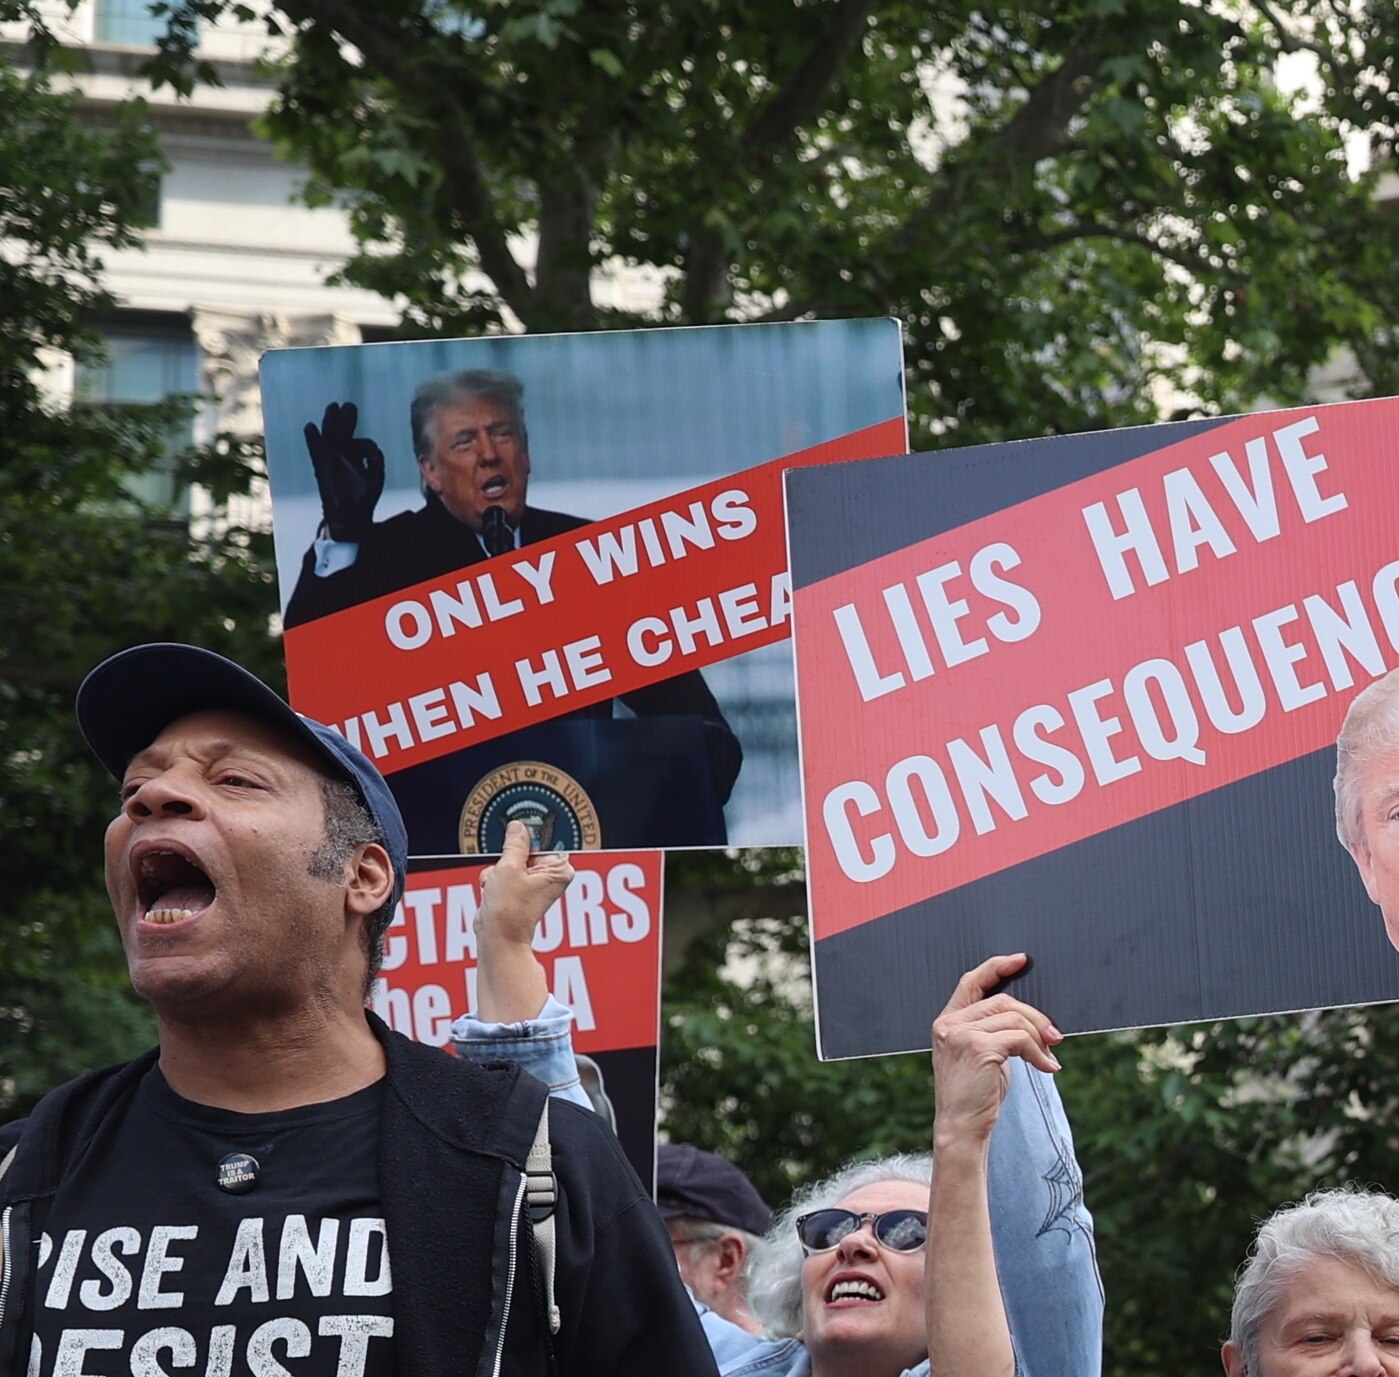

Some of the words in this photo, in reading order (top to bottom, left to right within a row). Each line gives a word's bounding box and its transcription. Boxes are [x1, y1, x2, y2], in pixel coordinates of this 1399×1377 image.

[385, 550, 558, 651] ONLY
[577, 489, 758, 586] WINS
[833, 541, 1042, 703] LIES
[1081, 416, 1349, 601] HAVE
[514, 635, 612, 707] HE
[218, 1173, 255, 1185] TRAITOR
[220, 1160, 249, 1171] TRUMP
[227, 1169, 236, 1177] IS
[38, 1224, 199, 1311] ISE
[214, 1214, 394, 1306] AND
